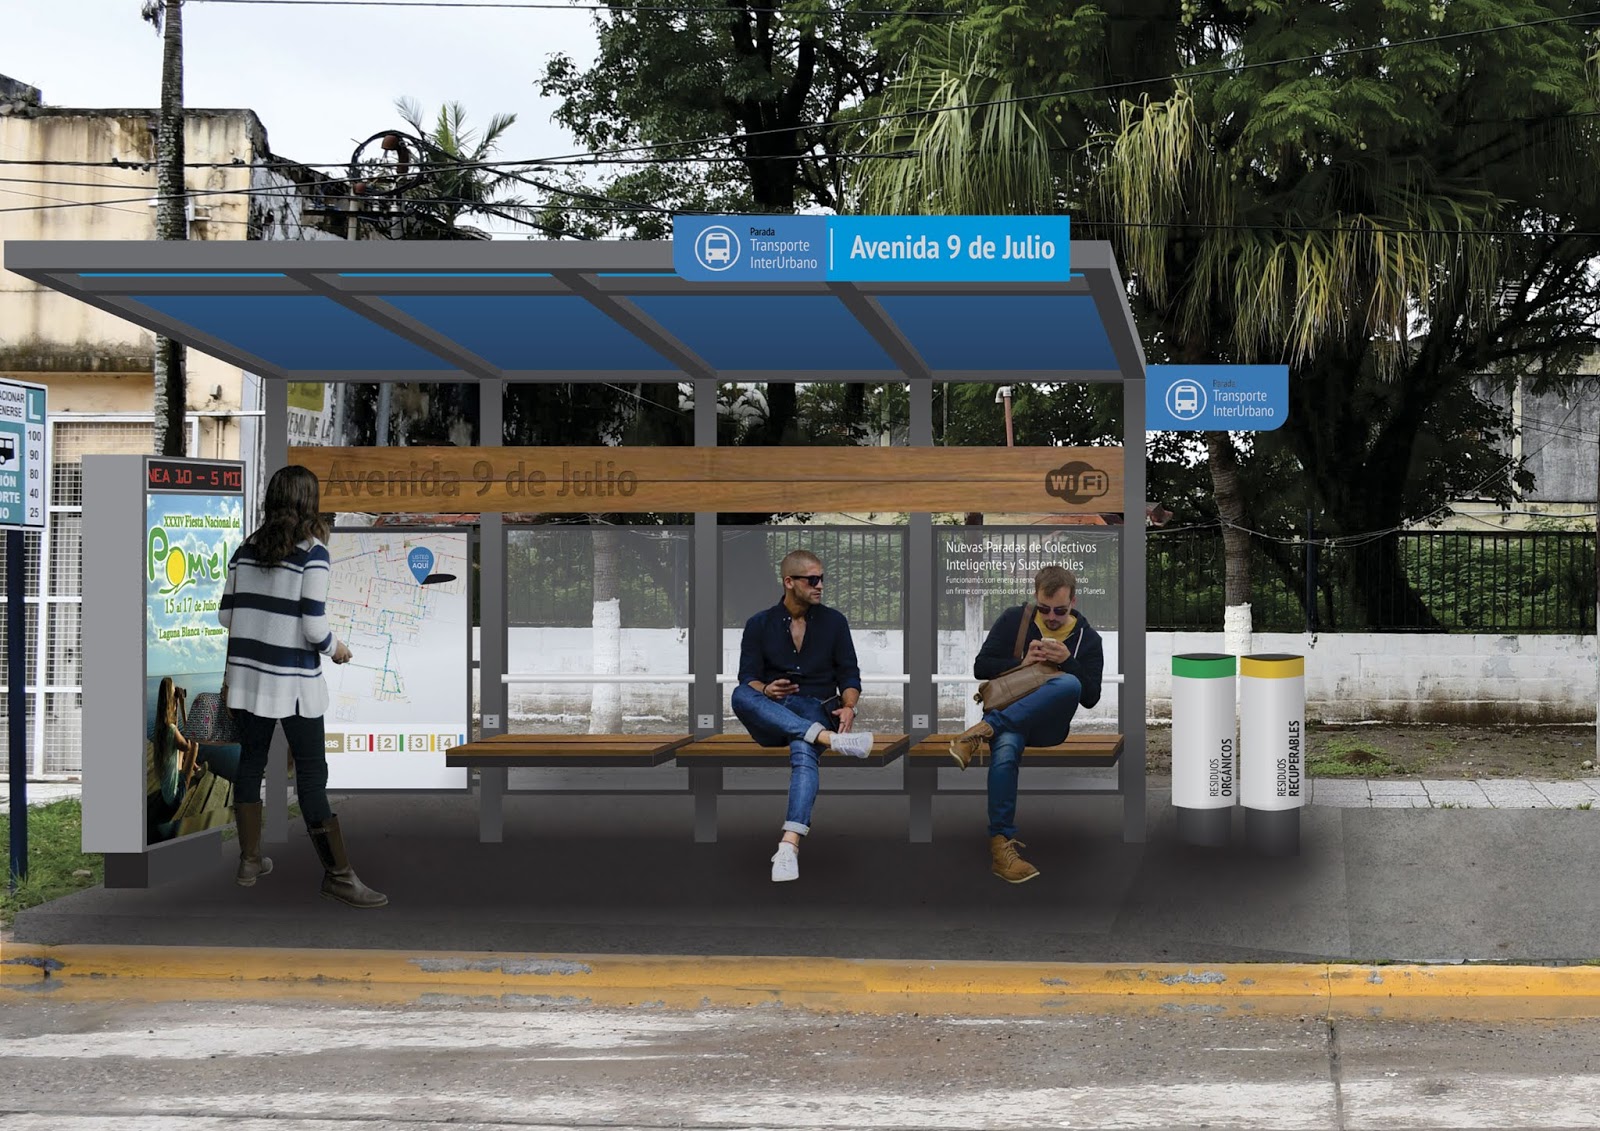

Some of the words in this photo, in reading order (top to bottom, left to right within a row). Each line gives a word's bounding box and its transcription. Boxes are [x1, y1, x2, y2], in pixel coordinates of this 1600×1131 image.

[750, 227, 775, 236] Parada
[750, 238, 810, 254] Transporte
[850, 235, 940, 259] Avenida
[947, 235, 961, 259] 9
[968, 235, 996, 259] de
[1002, 235, 1056, 259] Julio
[750, 256, 818, 269] InterUrbano
[1213, 389, 1267, 403] Transporte
[29, 393, 41, 420] L
[1213, 405, 1275, 417] InterUrbano
[28, 431, 41, 442] 100
[29, 450, 39, 460] 90
[29, 469, 39, 480] 80
[211, 471, 219, 485] 5
[323, 460, 461, 498] Avenida
[472, 460, 494, 498] 9
[505, 460, 547, 498] de
[555, 460, 638, 498] Julio
[29, 488, 39, 499] 40
[29, 507, 39, 518] 25
[163, 515, 184, 528] XXXIV
[185, 515, 204, 528] Fiesta
[205, 515, 231, 528] Nacional
[232, 518, 240, 528] del
[946, 541, 983, 553] Nuevas
[986, 541, 1026, 553] Paradas
[1028, 541, 1042, 553] de
[1044, 541, 1097, 553] Colectivos
[148, 526, 228, 592] Pomel
[946, 558, 1007, 573] Inteligentes
[1009, 561, 1016, 573] y
[165, 598, 174, 613] 15
[184, 597, 192, 612] 17
[194, 601, 201, 611] de
[202, 600, 216, 611] Julio
[159, 629, 180, 640] Laguna
[182, 627, 200, 637] Blanca
[355, 738, 361, 748] 1
[384, 738, 392, 748] 2
[415, 738, 423, 748] 3
[443, 738, 452, 748] 4
[1289, 720, 1300, 797] RECUPERABLES
[1219, 738, 1232, 797] ORGÁNICOS
[1210, 758, 1218, 797] RESIDUOS
[1277, 758, 1286, 797] RESIDUOS
